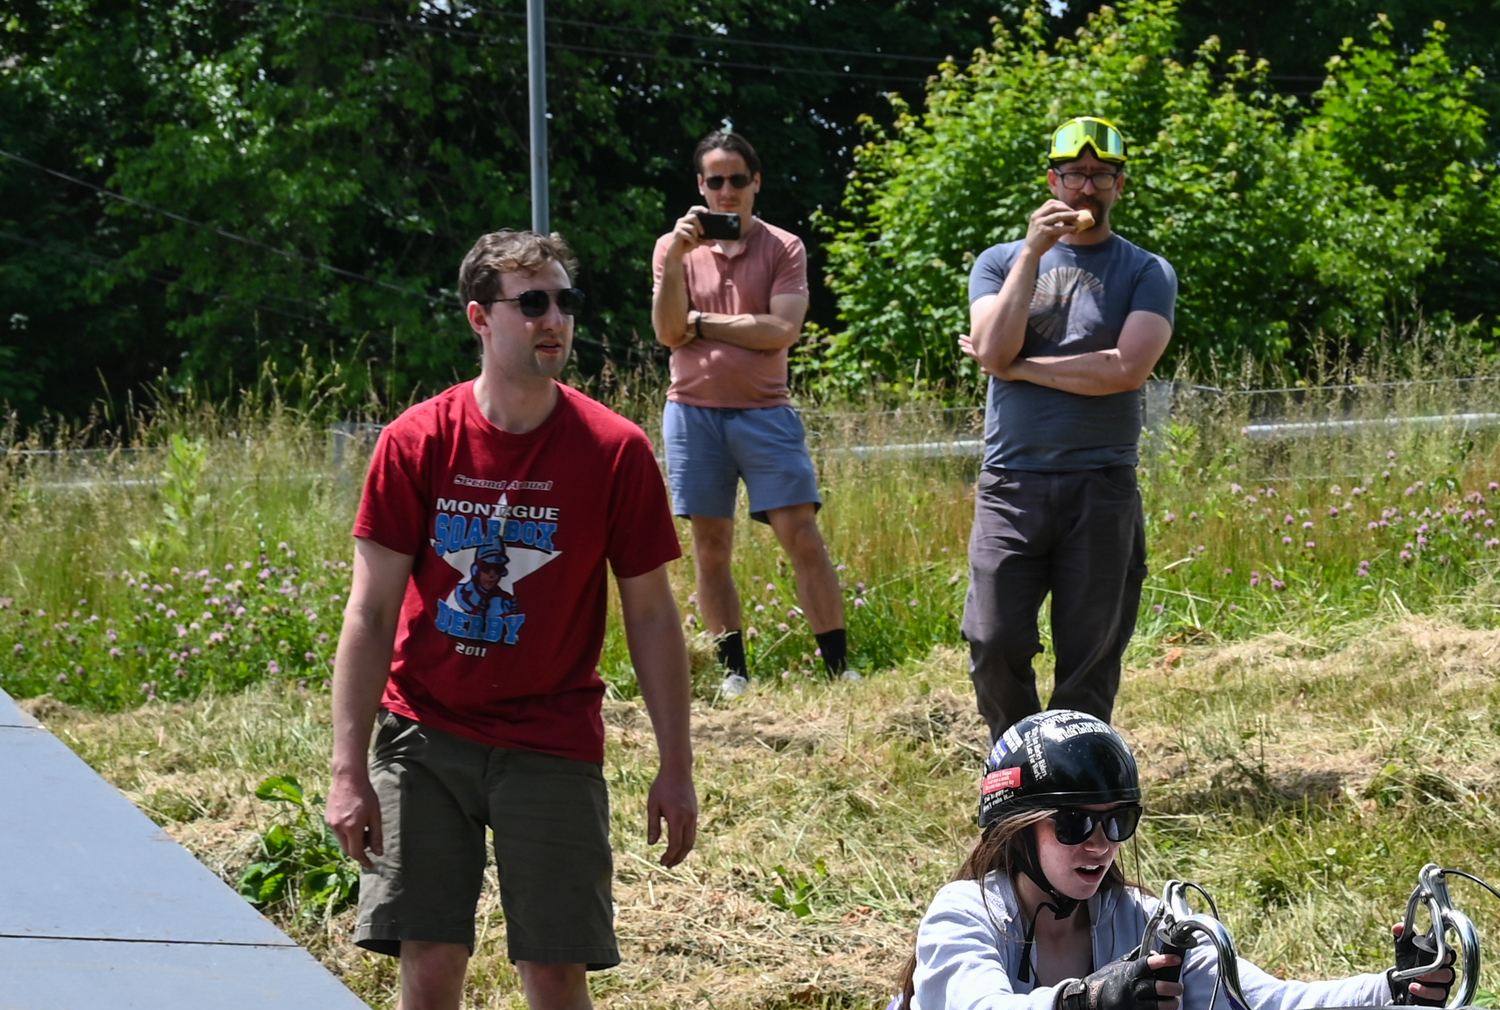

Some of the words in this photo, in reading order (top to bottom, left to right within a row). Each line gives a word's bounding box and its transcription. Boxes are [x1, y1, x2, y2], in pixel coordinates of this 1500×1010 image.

[453, 474, 507, 490] Second
[434, 598, 526, 645] DERBY
[455, 642, 487, 657] 2011
